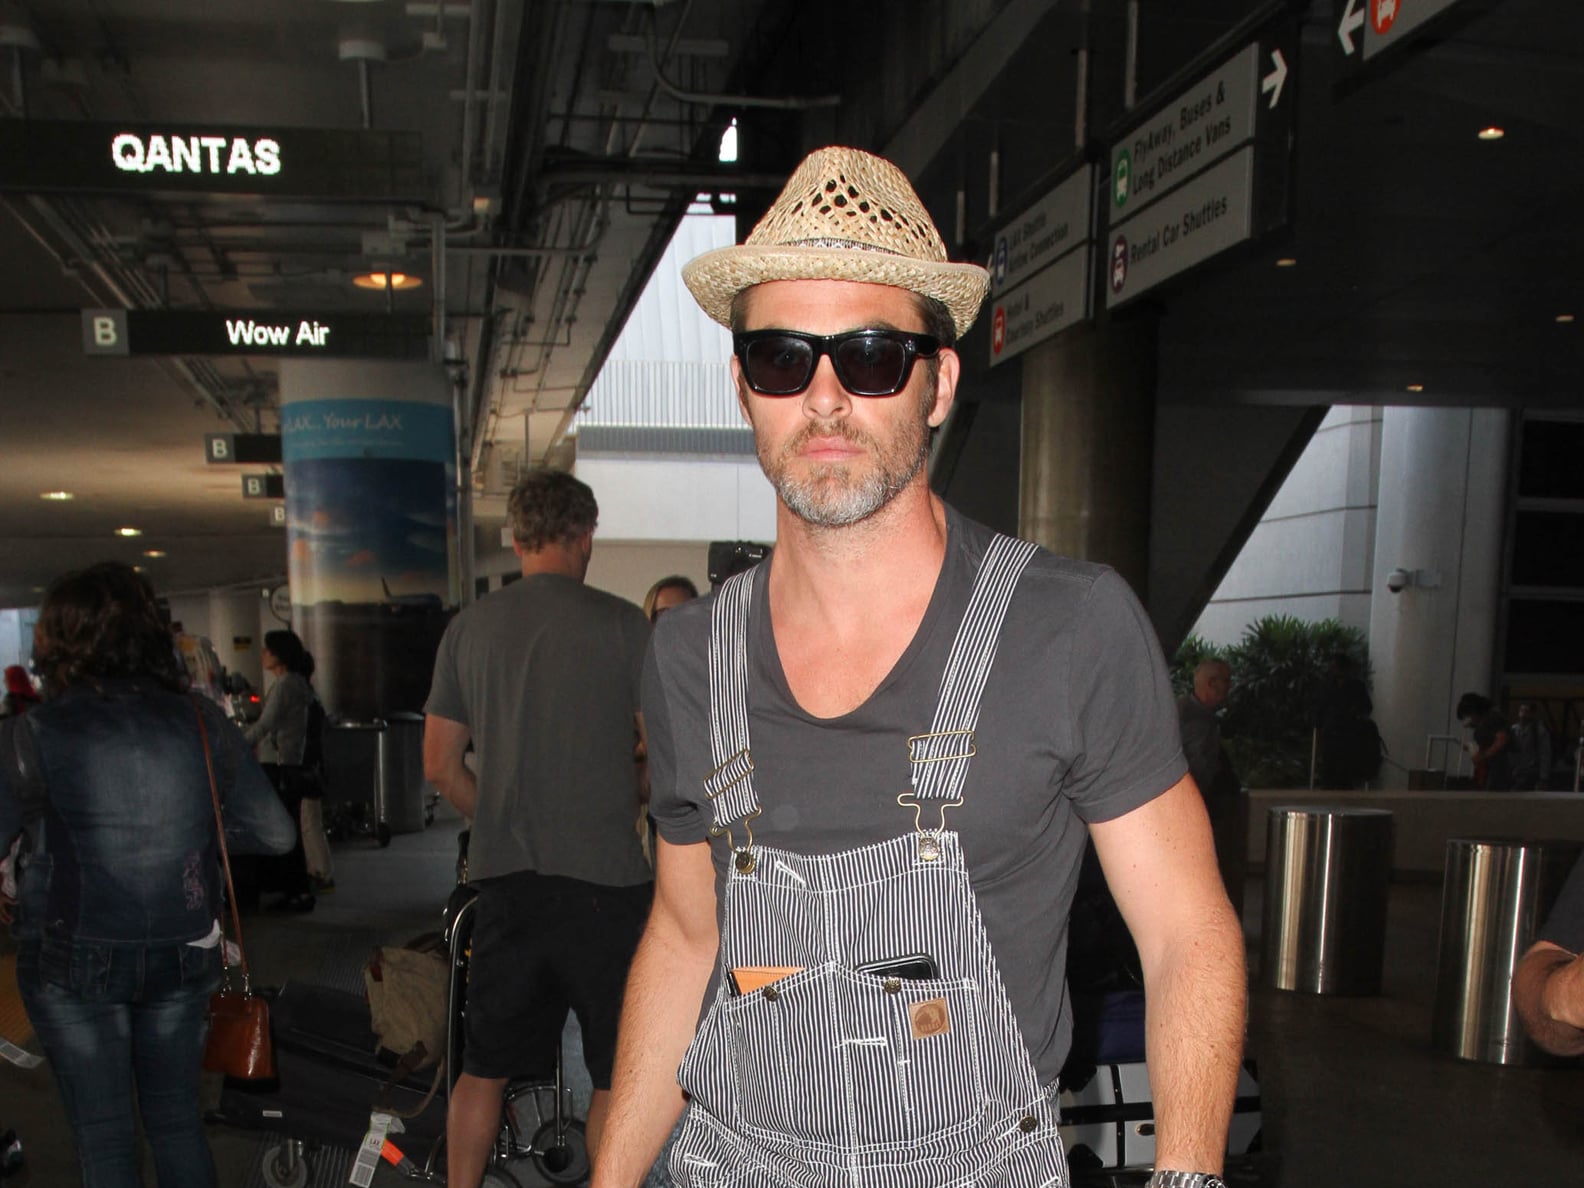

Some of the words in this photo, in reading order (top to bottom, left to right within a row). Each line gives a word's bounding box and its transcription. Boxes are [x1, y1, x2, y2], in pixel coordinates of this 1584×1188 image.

[1180, 93, 1212, 130] Buses
[1216, 80, 1225, 105] &
[112, 134, 281, 175] QANTAS
[1133, 166, 1155, 195] Long
[1158, 136, 1202, 178] Distance
[1205, 115, 1231, 147] Vans
[1131, 230, 1160, 263] Rental
[1163, 223, 1180, 247] Car
[1183, 197, 1227, 236] Shuttles
[93, 317, 117, 345] B
[226, 320, 289, 345] Wow
[296, 321, 330, 345] Air
[322, 411, 362, 430] Your
[364, 411, 403, 430] LAX
[212, 439, 228, 458] B
[247, 478, 260, 495] B
[274, 507, 285, 522] B
